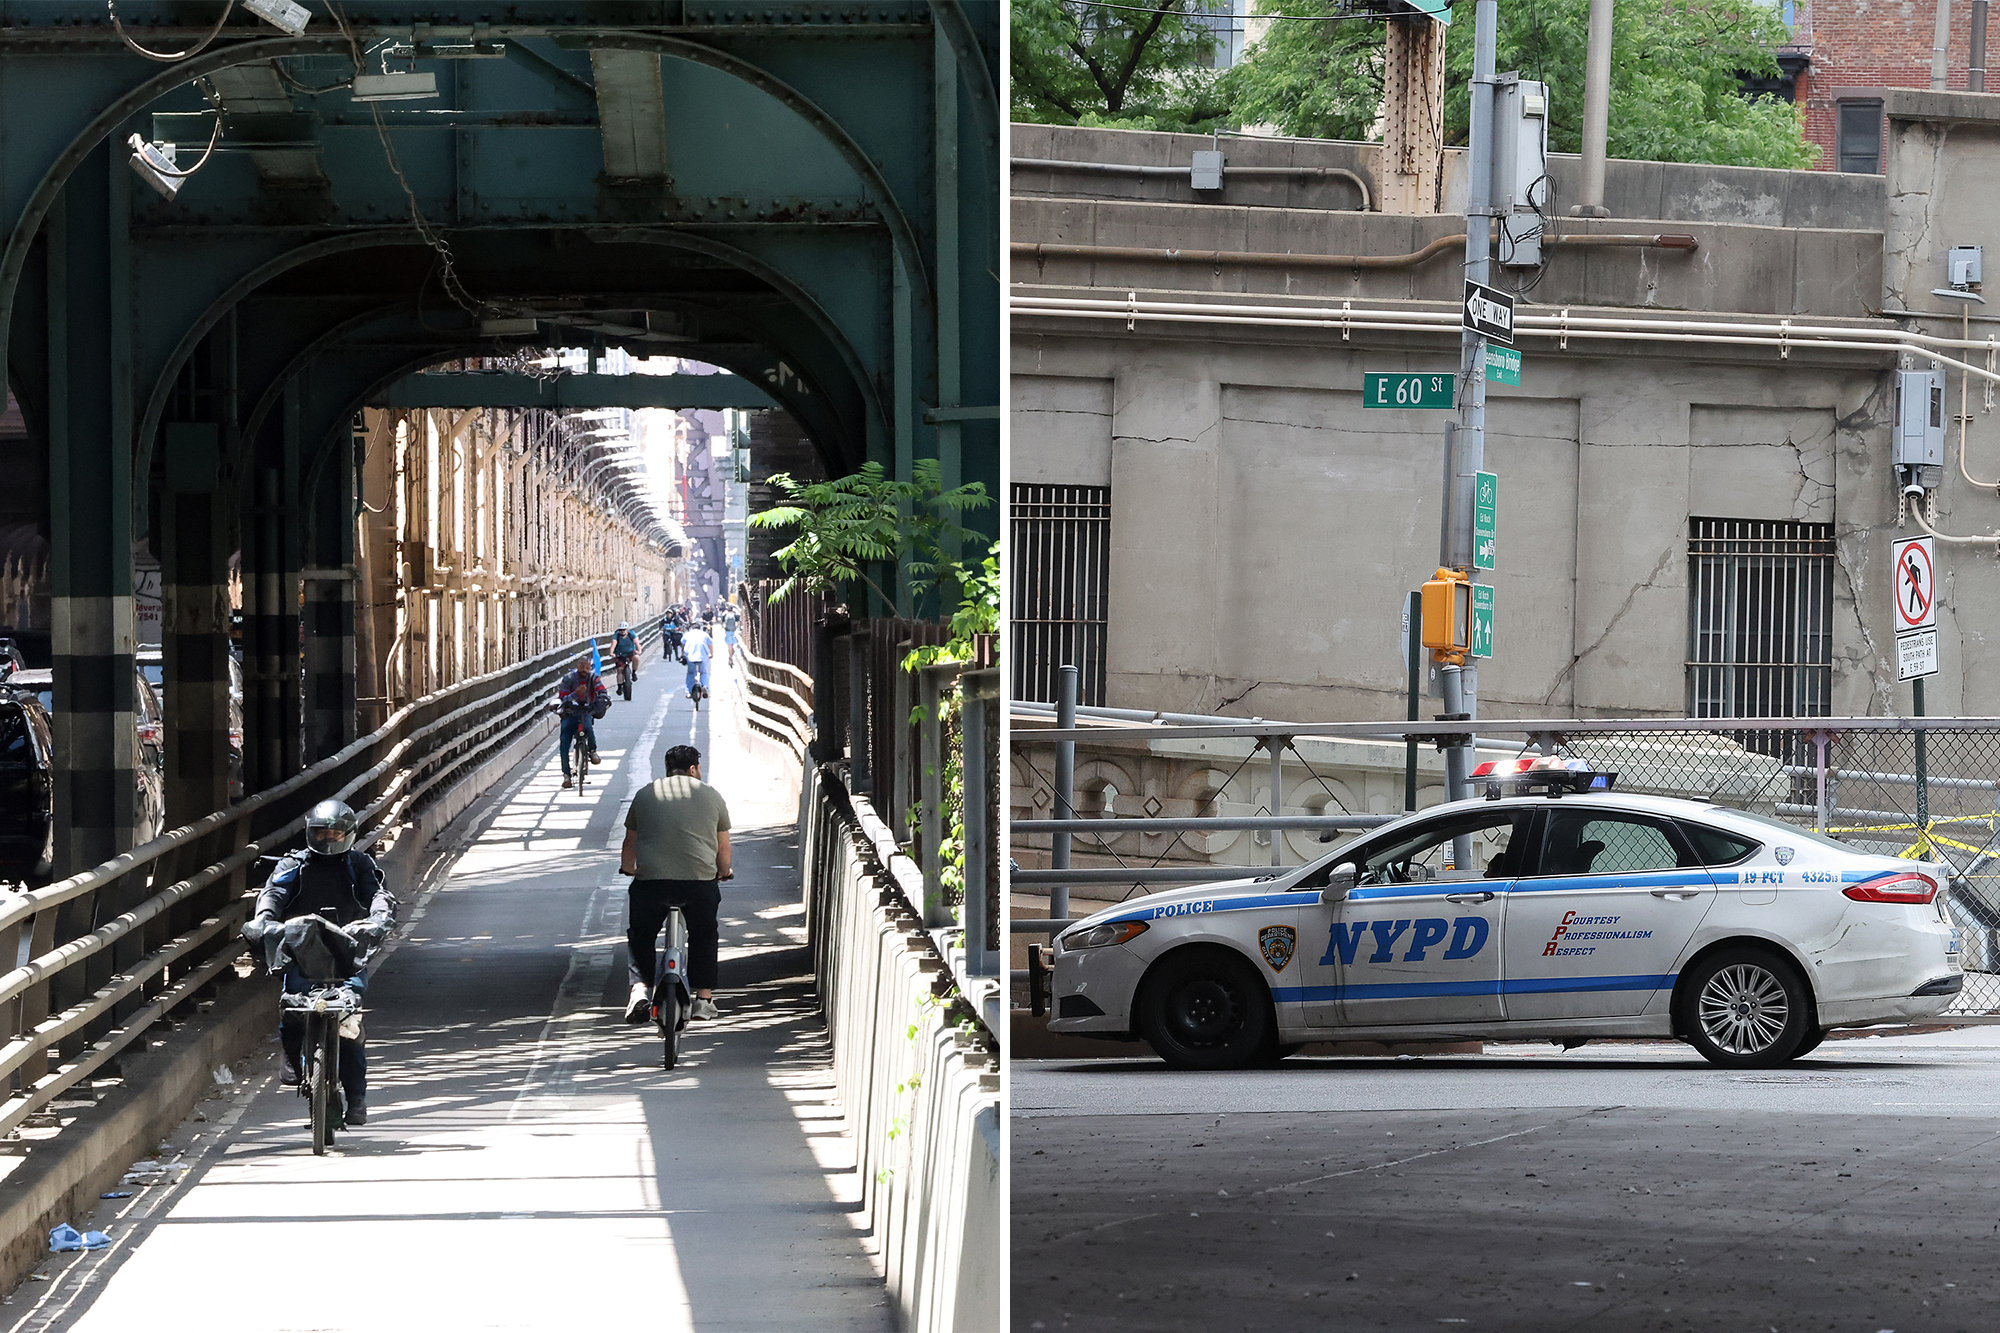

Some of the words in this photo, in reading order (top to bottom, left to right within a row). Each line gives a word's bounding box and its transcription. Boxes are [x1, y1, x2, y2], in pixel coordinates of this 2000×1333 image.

[1472, 298, 1487, 318] ONE
[1492, 305, 1508, 326] WAY
[1486, 350, 1505, 369] eensboro
[1506, 353, 1520, 377] Bridge
[1377, 378, 1389, 404] E
[1396, 378, 1422, 404] 60
[1431, 376, 1443, 392] St
[1925, 636, 1933, 646] USE
[1903, 651, 1915, 662] SOUTH
[1915, 649, 1925, 659] PATH
[1926, 648, 1931, 657] AT
[1744, 871, 1757, 884] 19
[1762, 871, 1784, 884] PCT
[1155, 900, 1212, 919] POLICE
[1319, 916, 1489, 966] NYPD
